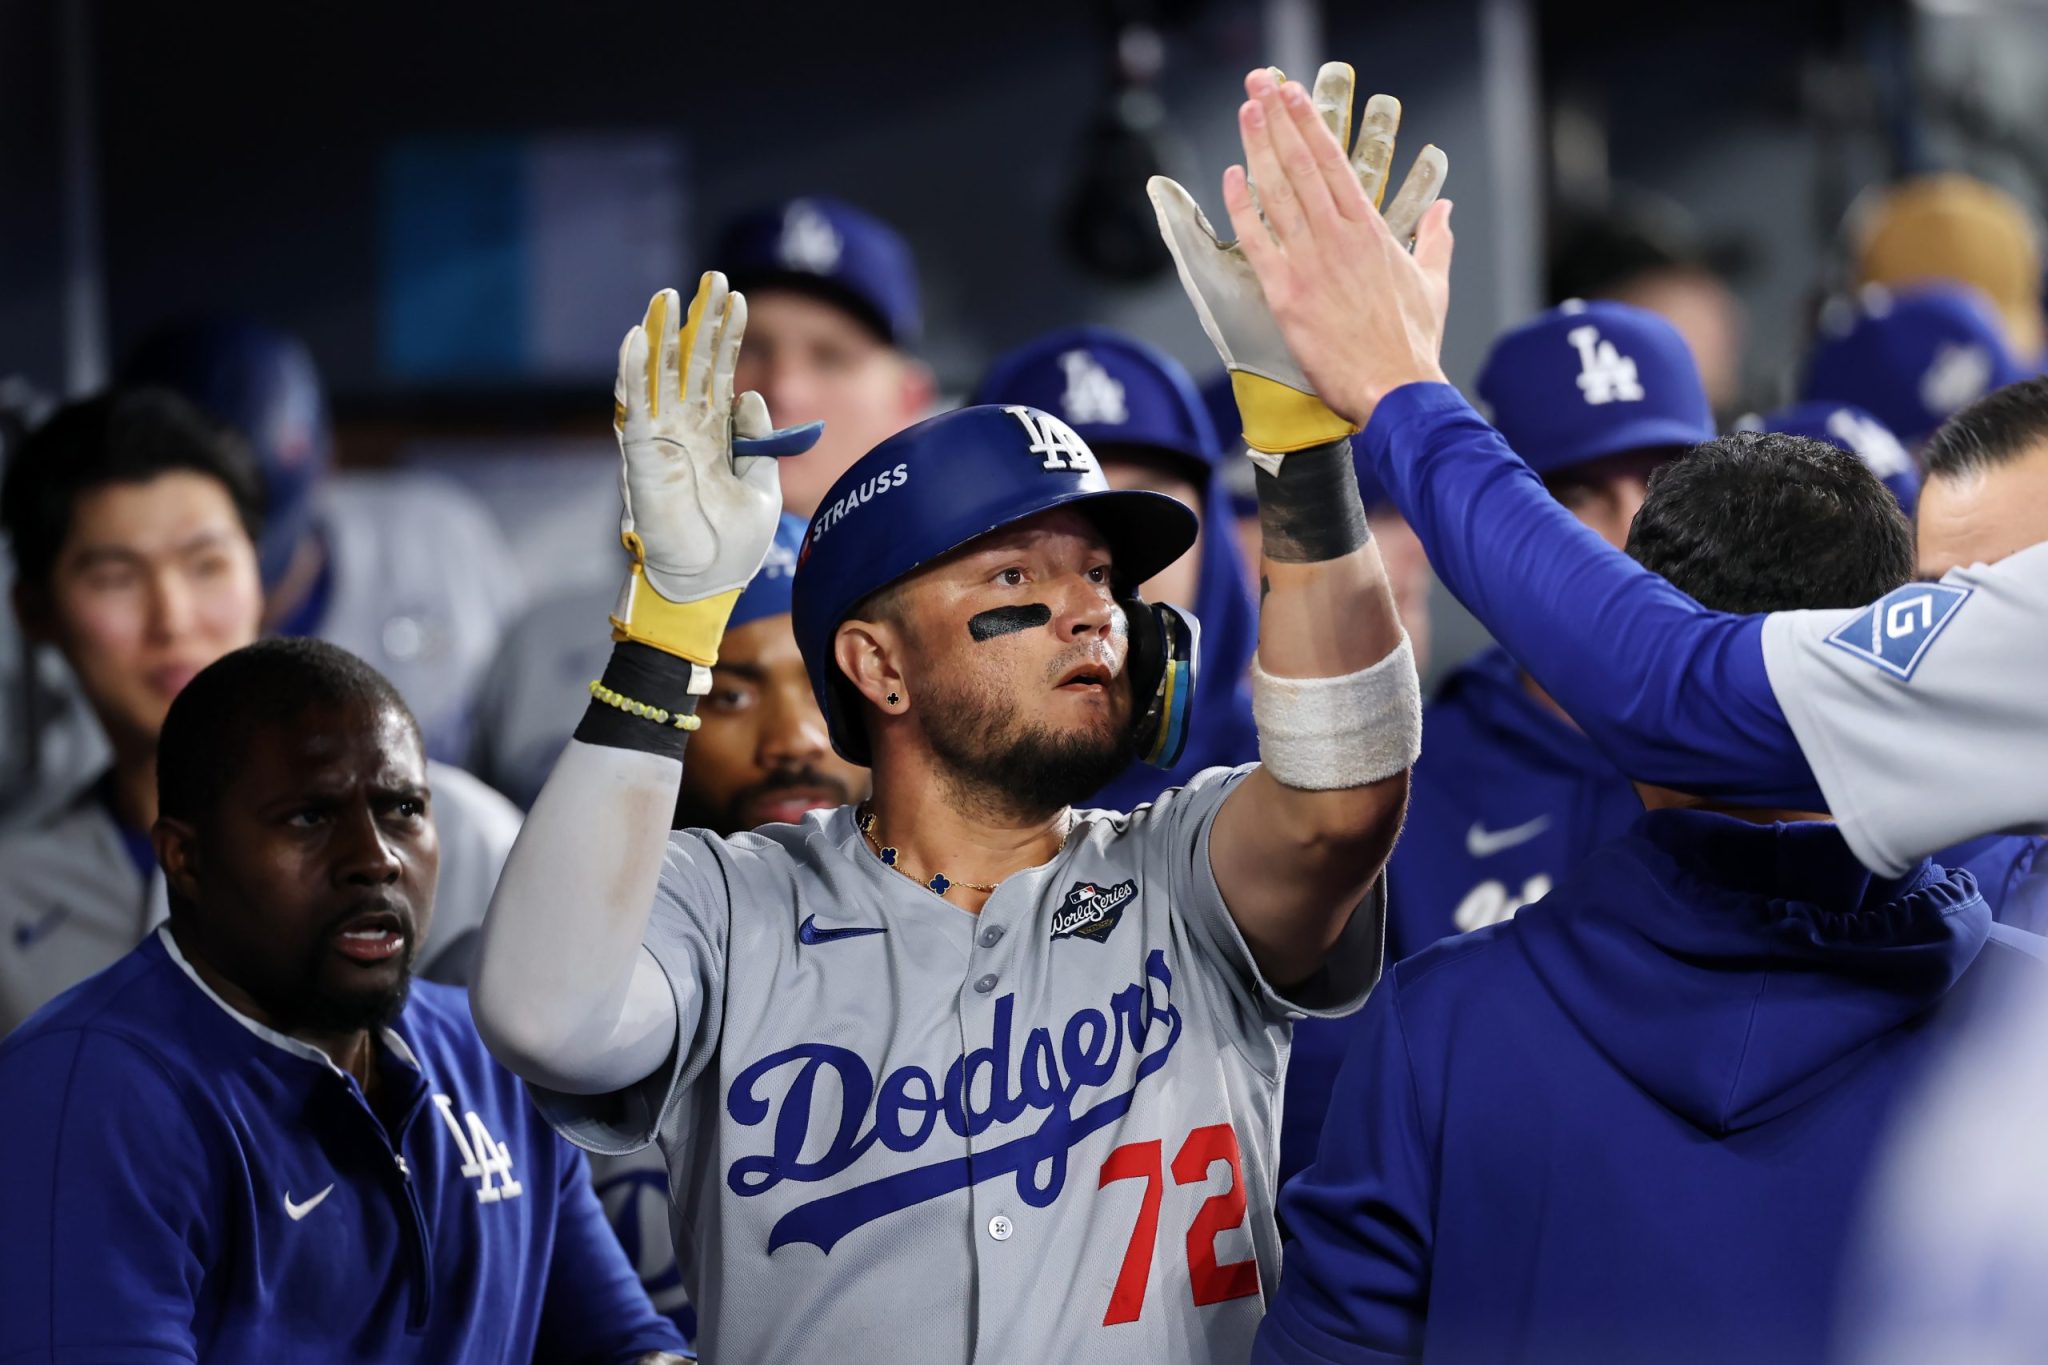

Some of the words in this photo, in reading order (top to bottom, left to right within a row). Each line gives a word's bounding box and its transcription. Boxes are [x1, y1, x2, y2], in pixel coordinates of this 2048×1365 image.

[1567, 325, 1645, 404] LA
[1005, 405, 1090, 469] LA
[812, 463, 908, 542] STRAUSS
[1090, 884, 1132, 922] Series
[727, 948, 1182, 1208] Dodgers
[432, 1093, 523, 1203] LA
[1098, 1122, 1259, 1327] 72
